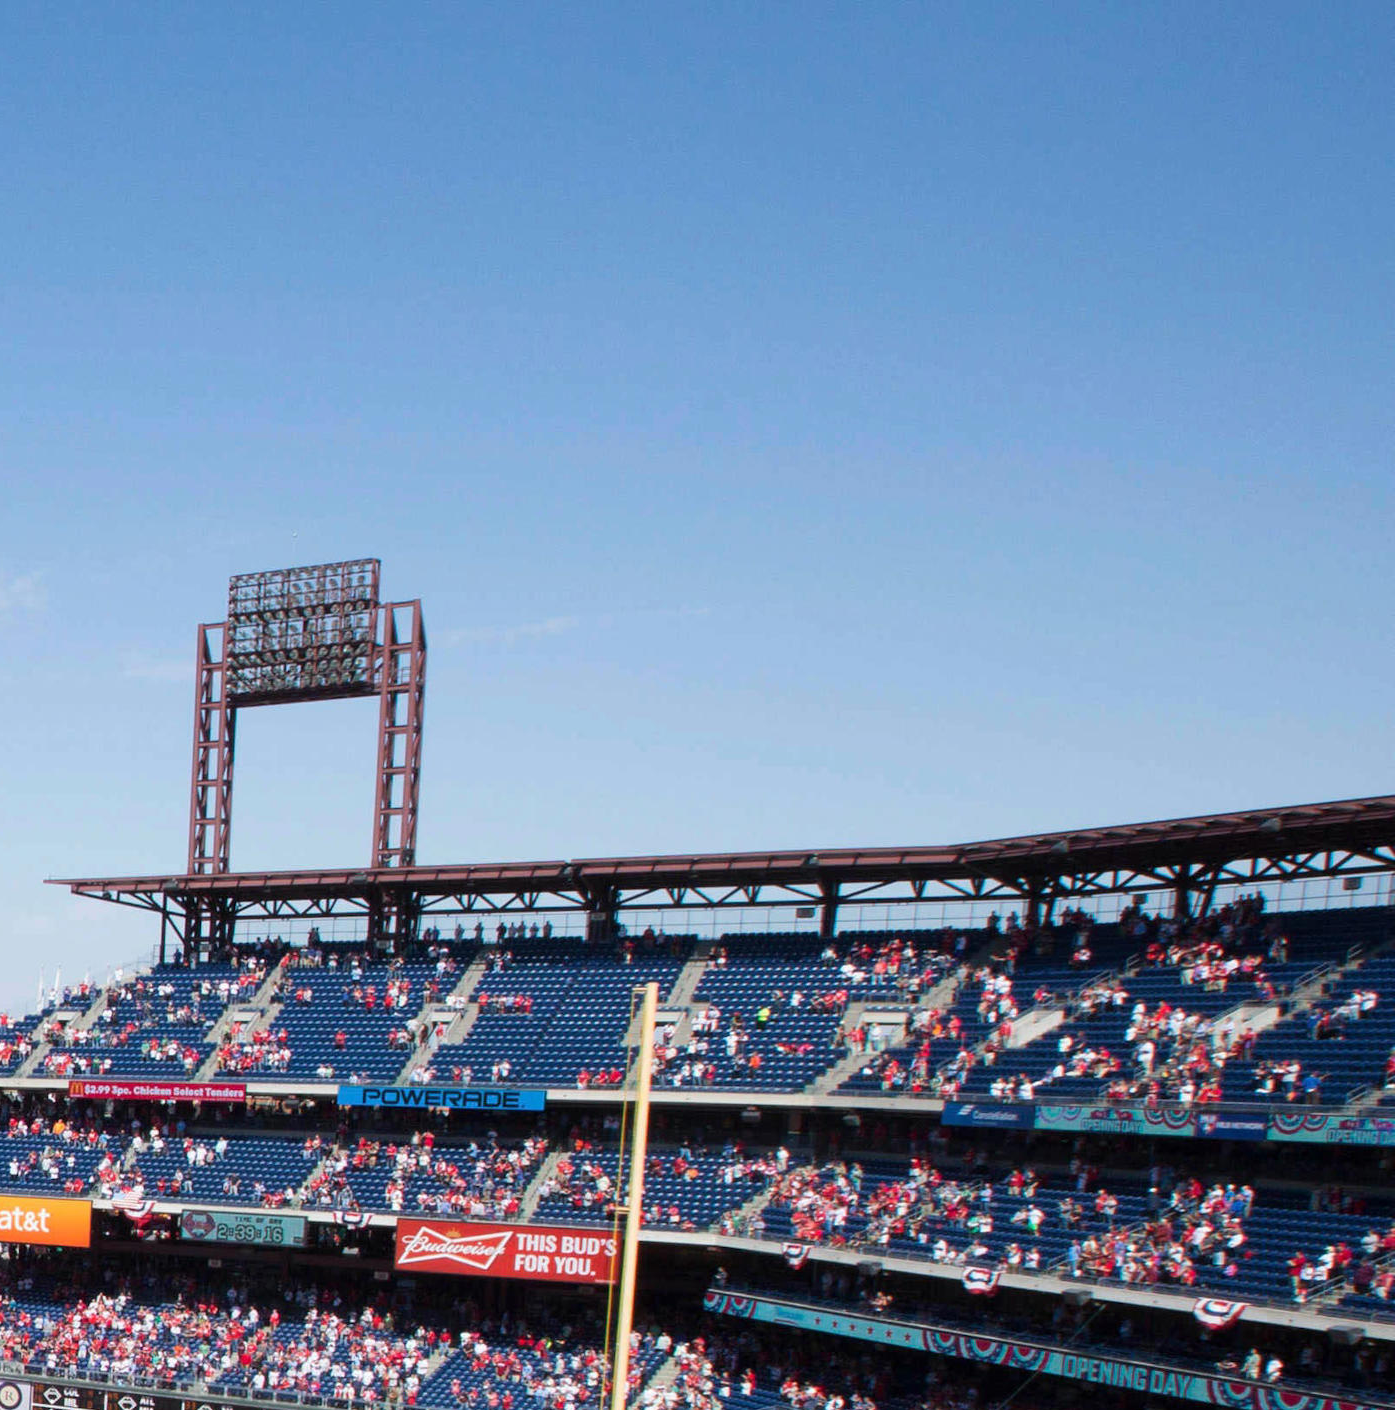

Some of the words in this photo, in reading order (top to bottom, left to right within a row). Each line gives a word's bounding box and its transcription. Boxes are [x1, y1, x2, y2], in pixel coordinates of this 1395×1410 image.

[84, 1084, 110, 1095] $2.99
[134, 1086, 171, 1096] Chicken
[173, 1087, 204, 1097] Select
[205, 1088, 244, 1098] Tenders
[362, 1088, 520, 1108] POWERADE
[1082, 1119, 1122, 1131] OPENING
[1123, 1121, 1142, 1132] DAY
[1328, 1128, 1377, 1144] OPENING
[217, 1223, 284, 1244] 2:39:16
[402, 1234, 507, 1259] Budweiser
[516, 1233, 557, 1252] THIS
[562, 1235, 617, 1256] BUD'S
[515, 1254, 548, 1273] FOR
[552, 1256, 597, 1277] YOU.
[1063, 1352, 1147, 1390] OPENING
[1150, 1370, 1193, 1397] DAY
[63, 1398, 77, 1408] MIL
[140, 1396, 155, 1406] ATL
